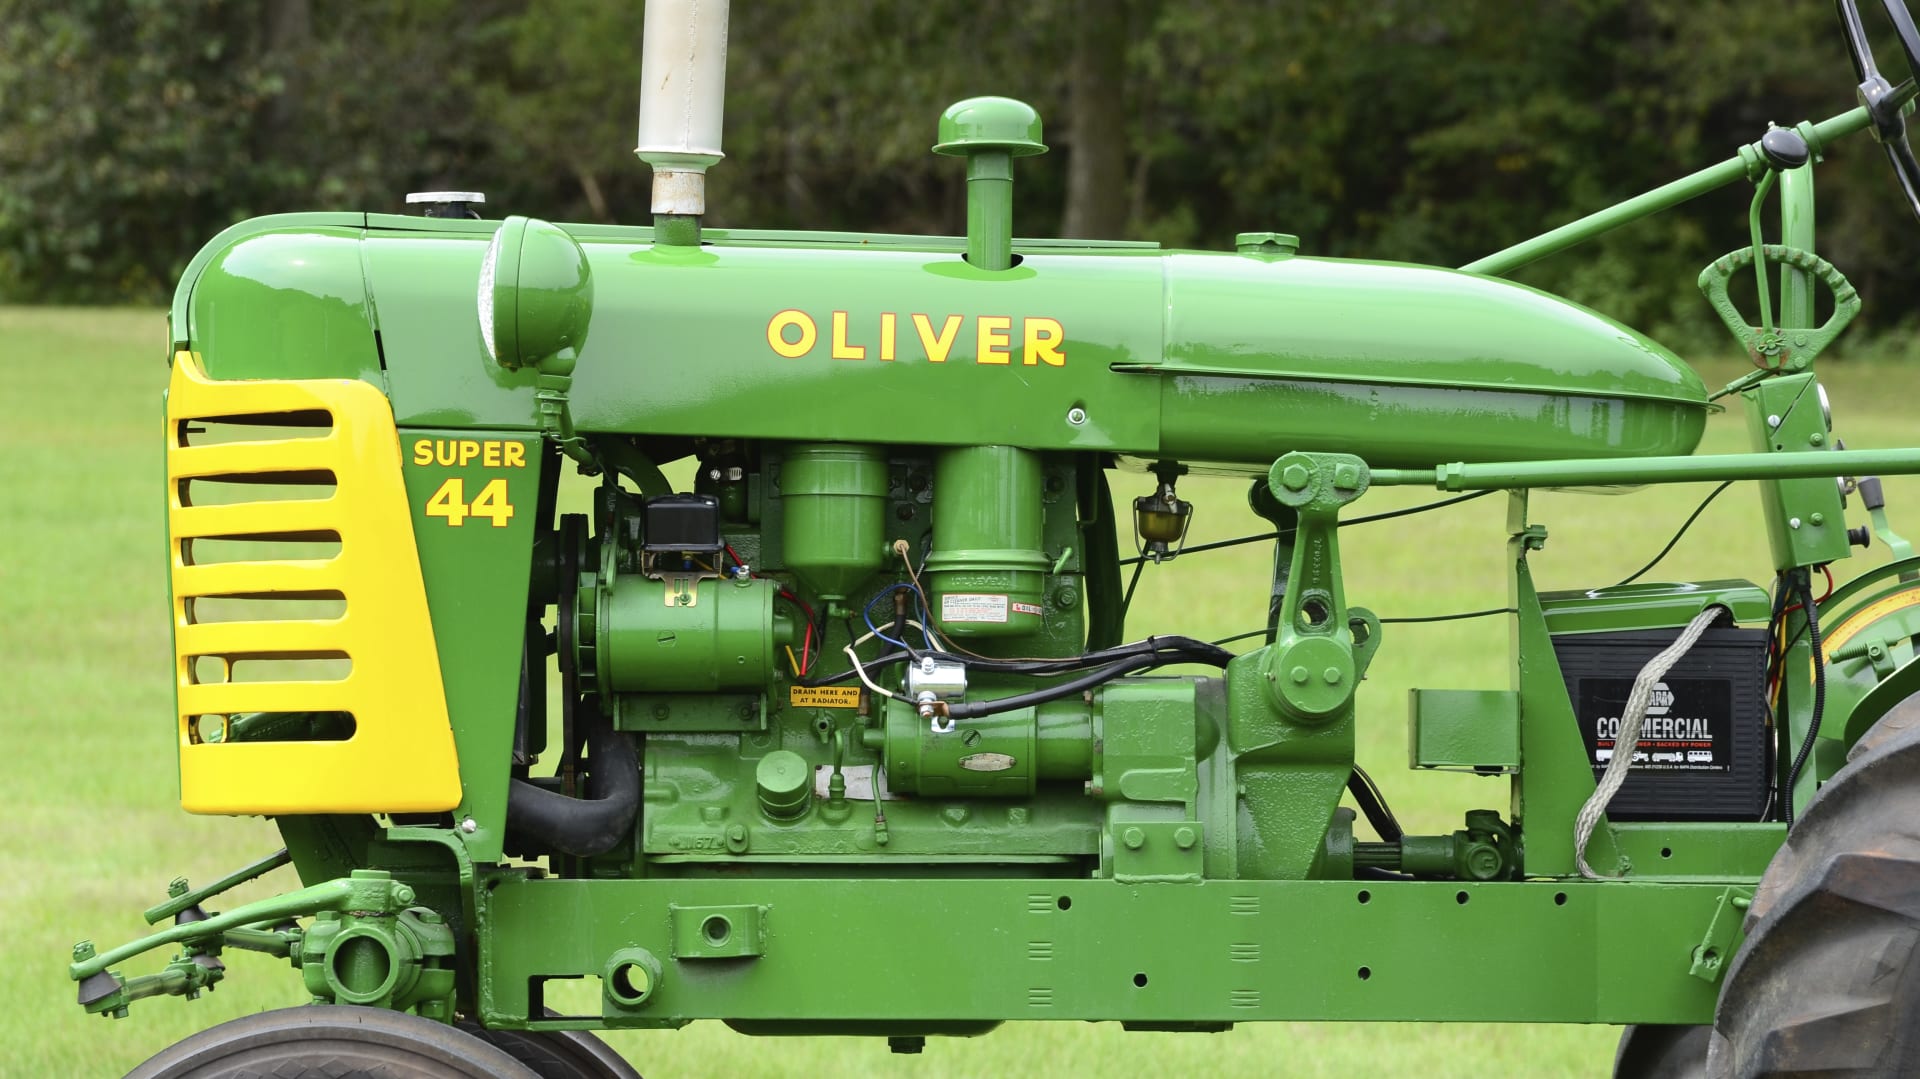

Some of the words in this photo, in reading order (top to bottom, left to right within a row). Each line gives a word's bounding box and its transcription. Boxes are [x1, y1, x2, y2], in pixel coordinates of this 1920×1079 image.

[766, 308, 1067, 368] OLIVER
[413, 438, 527, 469] SUPER
[425, 477, 515, 529] 44
[1596, 716, 1713, 740] COMERCIAL
